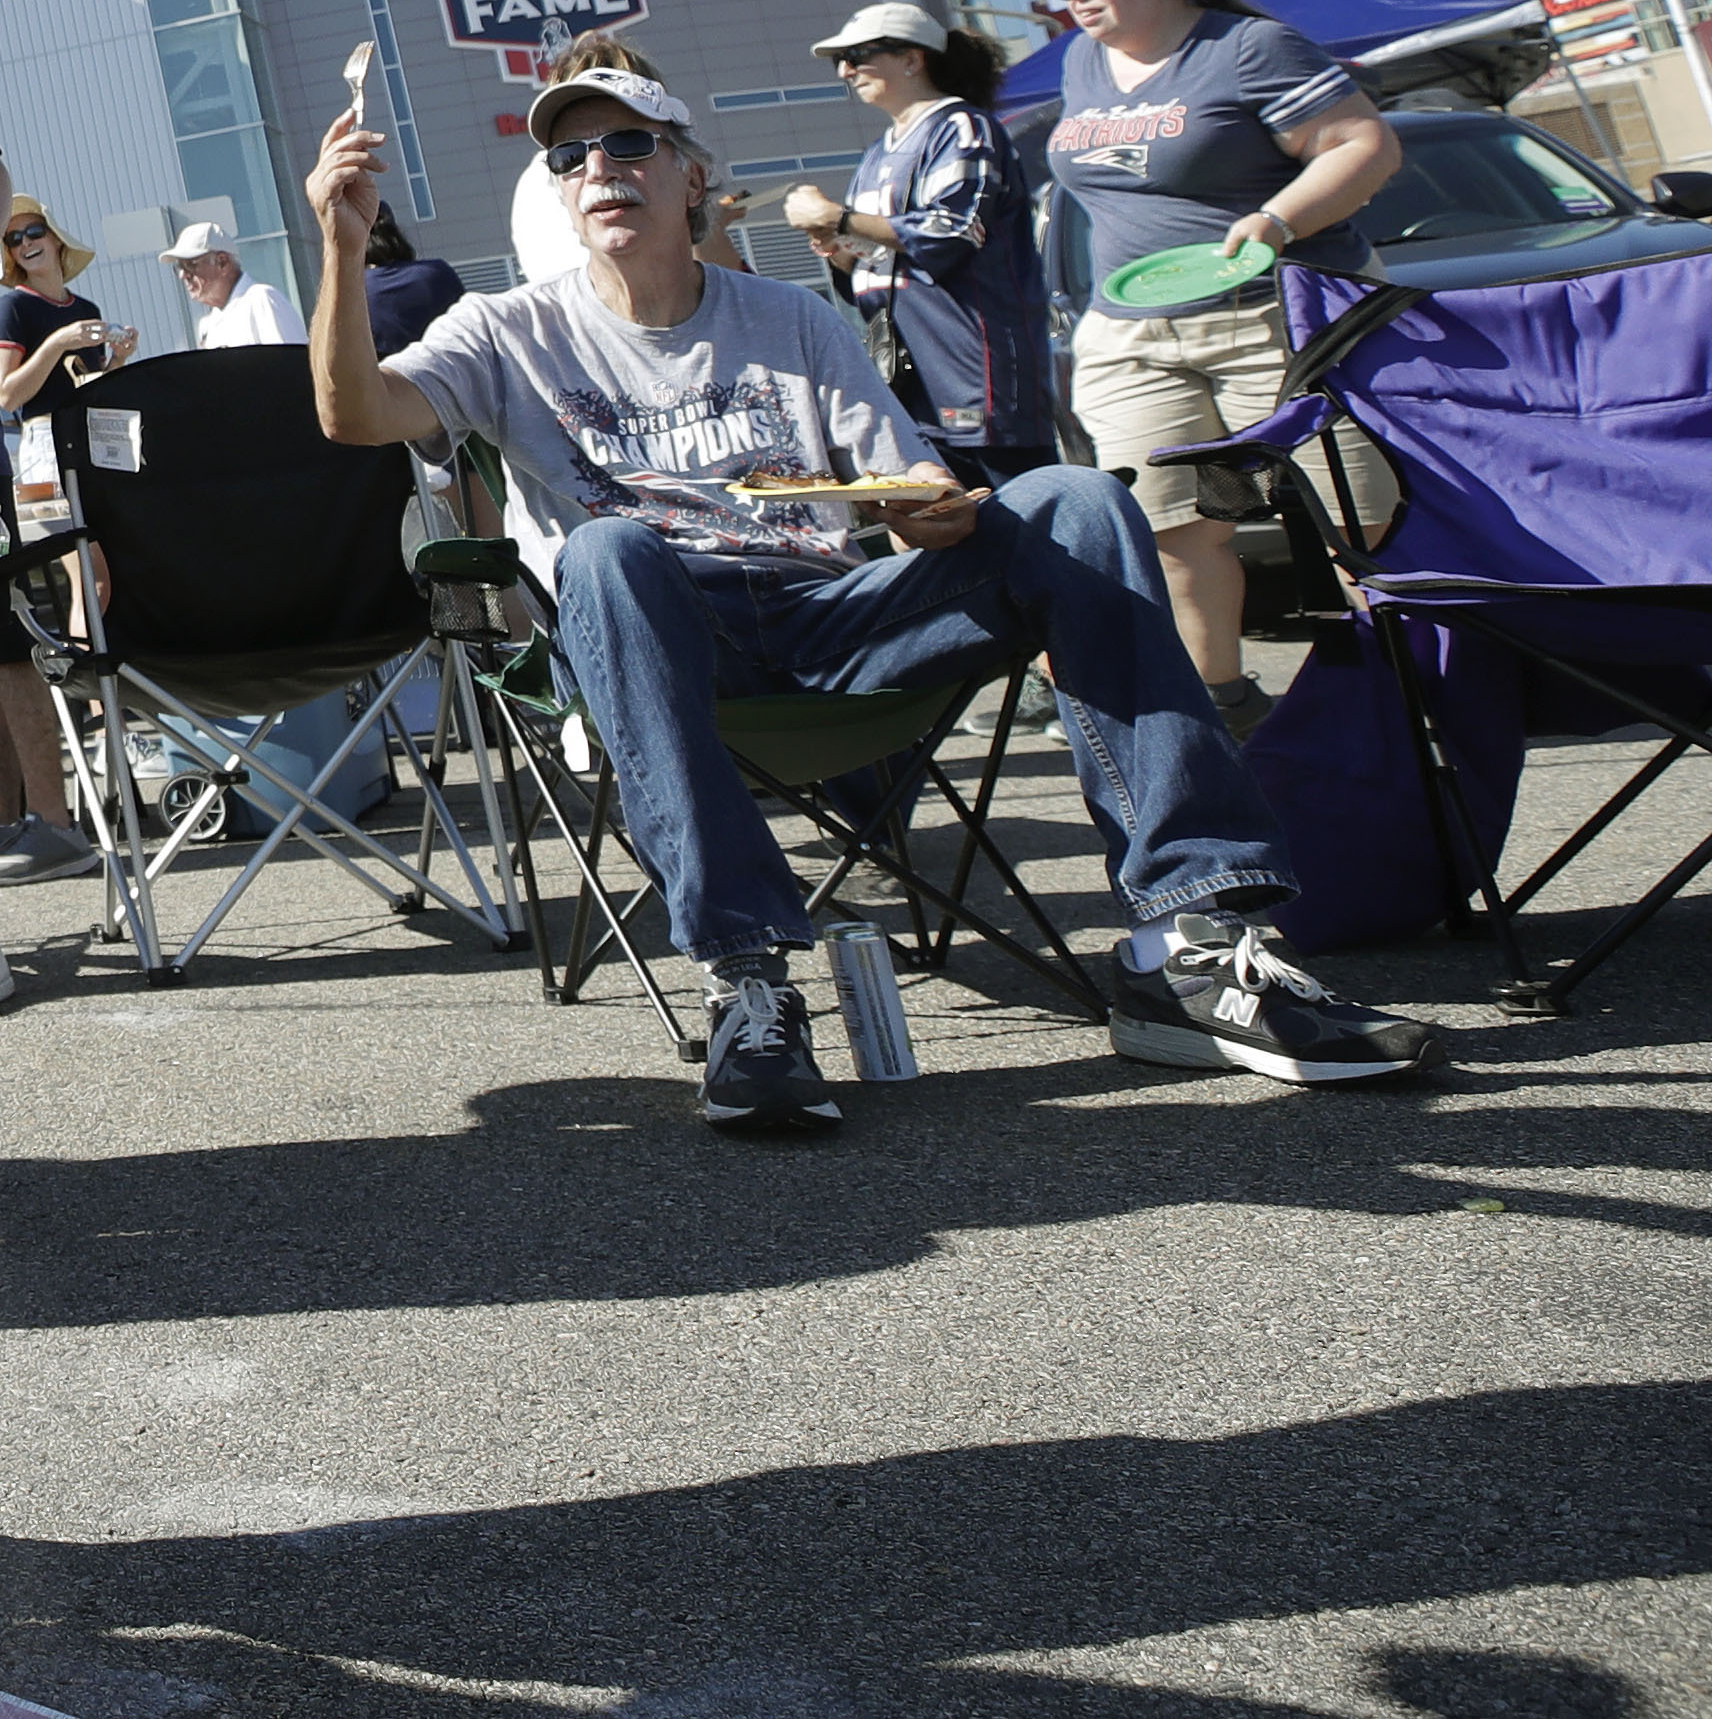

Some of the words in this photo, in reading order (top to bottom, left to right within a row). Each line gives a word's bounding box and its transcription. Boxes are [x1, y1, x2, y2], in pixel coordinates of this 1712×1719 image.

[1048, 105, 1188, 154] PATRIOTS
[618, 413, 670, 436] SUPER
[674, 399, 719, 427] BOWL
[582, 408, 774, 473] CHAMPIONS
[1213, 986, 1261, 1028] N
